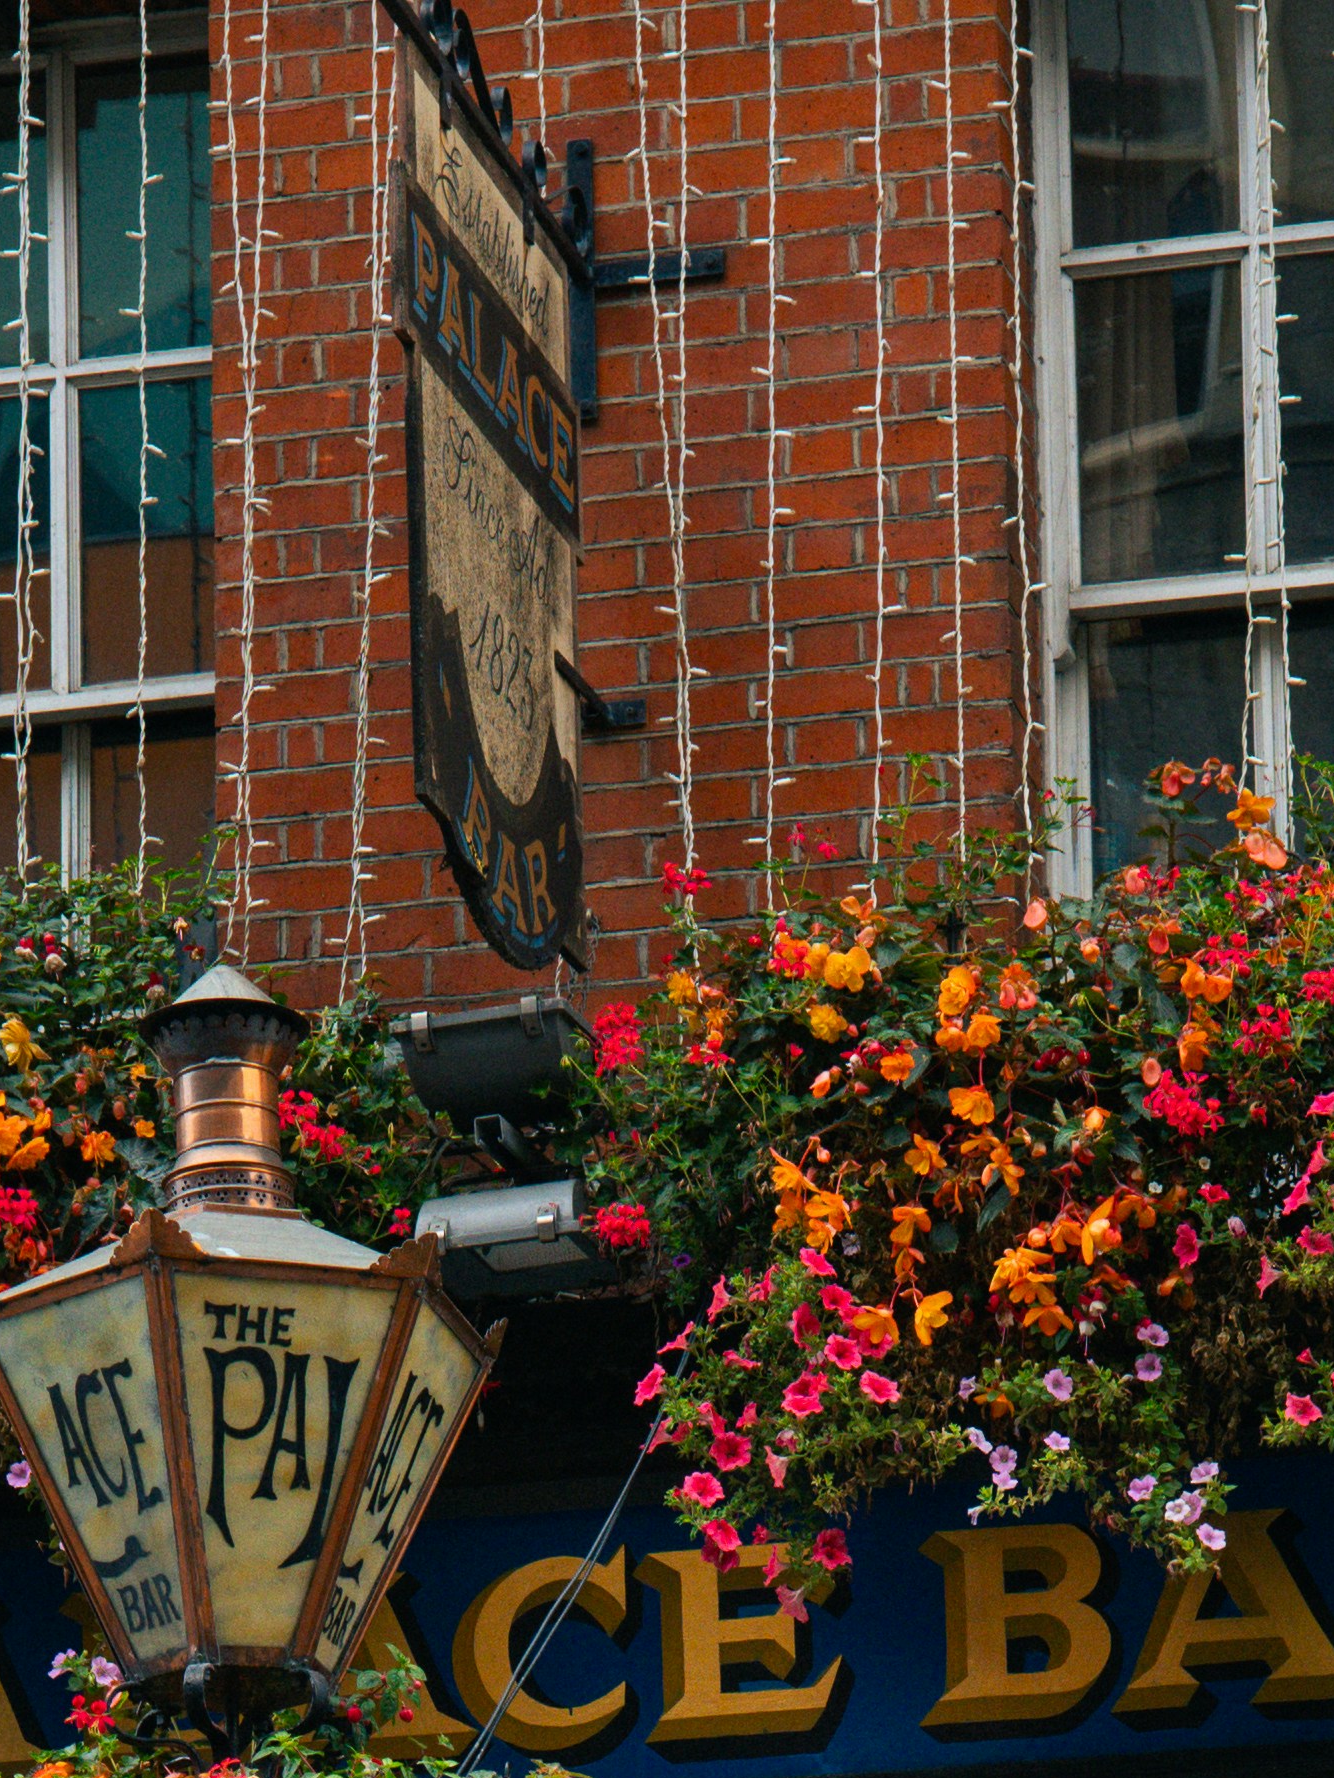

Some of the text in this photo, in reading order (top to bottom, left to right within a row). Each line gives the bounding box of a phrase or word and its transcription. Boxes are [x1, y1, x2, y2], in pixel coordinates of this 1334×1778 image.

[434, 133, 551, 337] Established
[411, 208, 576, 515] PALACE
[442, 416, 505, 545] Since
[470, 604, 535, 732] 1823
[457, 755, 559, 948] BAR
[204, 1301, 296, 1346] THE
[47, 1358, 163, 1516] ACE
[203, 1346, 360, 1569] PAL
[365, 1371, 443, 1550] ACE
[118, 1574, 181, 1633] BAR
[322, 1586, 357, 1649] BAR
